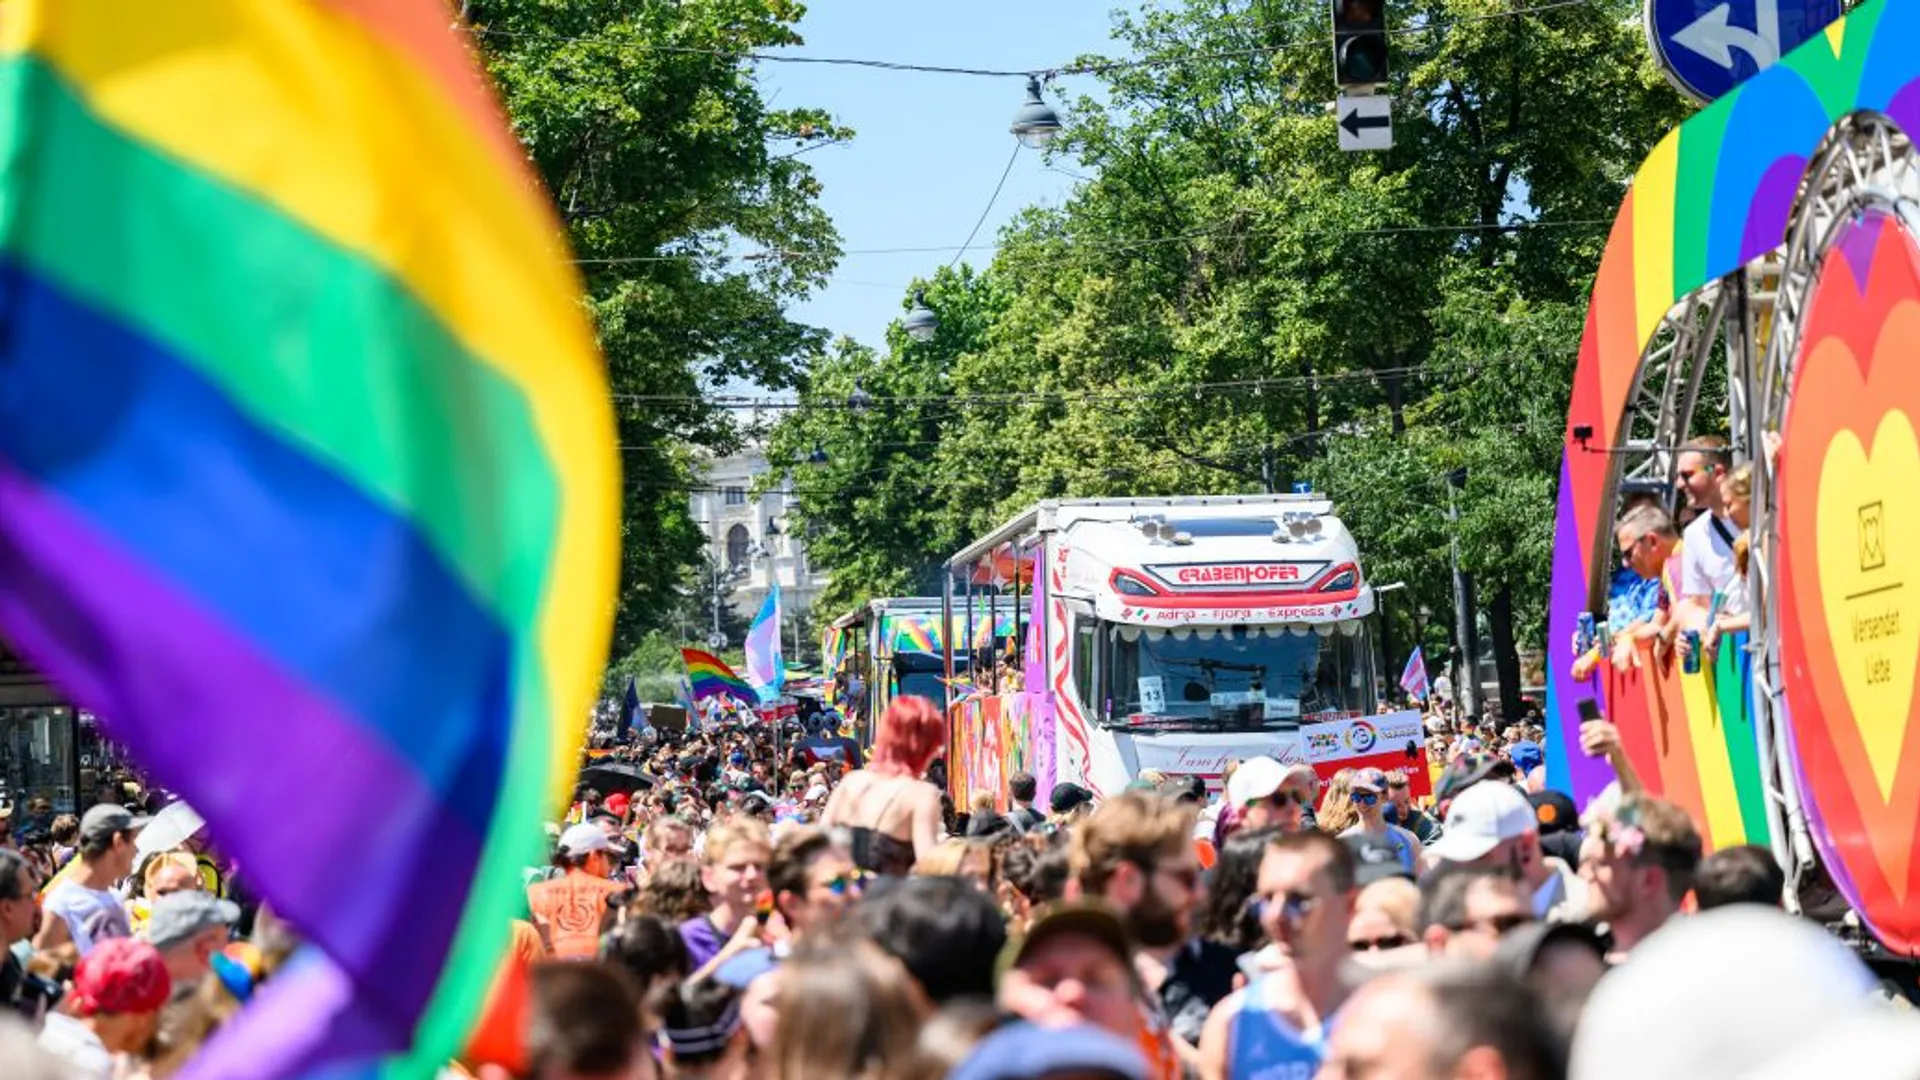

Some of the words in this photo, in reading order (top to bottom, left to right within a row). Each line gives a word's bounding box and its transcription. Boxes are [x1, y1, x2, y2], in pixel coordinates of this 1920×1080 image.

[1178, 565, 1299, 584] GRABENHOFER
[1268, 607, 1325, 620] Express
[1853, 609, 1900, 642] Versendet
[1865, 653, 1891, 686] Liebe
[1144, 689, 1161, 702] 13
